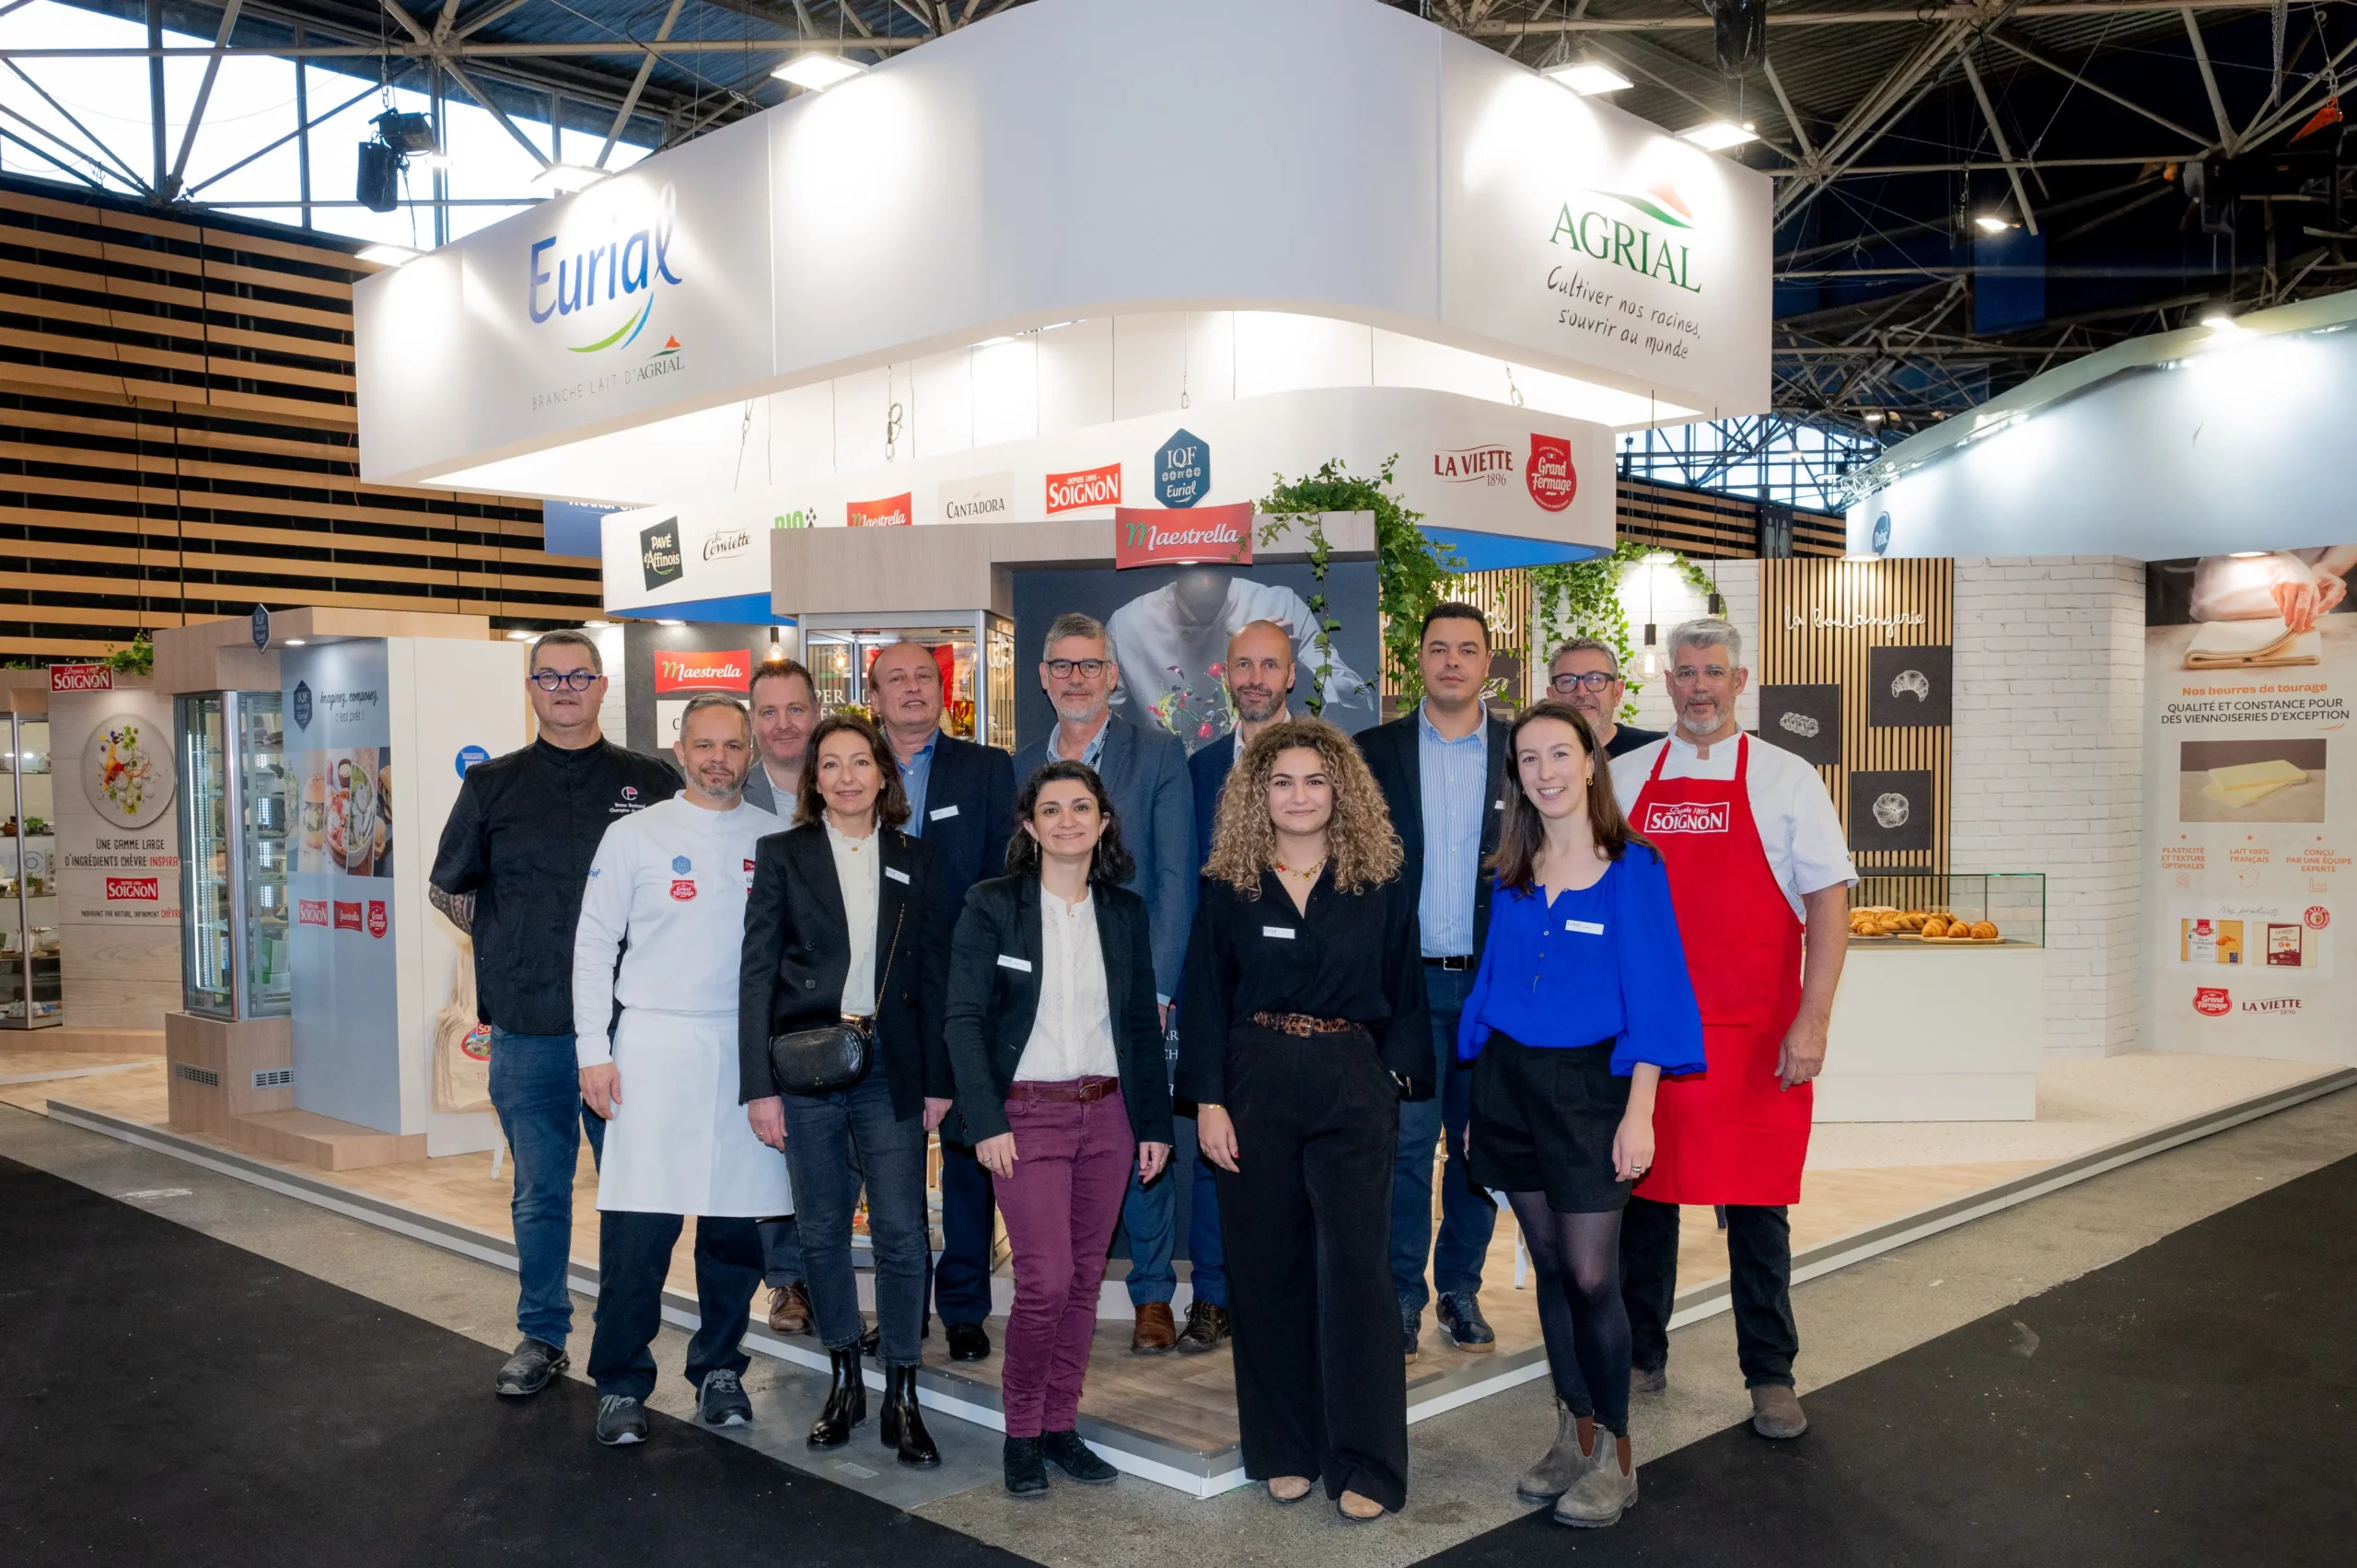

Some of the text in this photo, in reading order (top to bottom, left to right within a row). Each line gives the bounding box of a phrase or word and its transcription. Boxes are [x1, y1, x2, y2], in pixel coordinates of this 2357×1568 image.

[528, 181, 683, 324] Eurial
[1548, 201, 1702, 294] AGRIAL
[1547, 264, 1701, 340] Cultiver nos racines,
[1558, 308, 1689, 360] s'ouvrir au monde
[531, 356, 685, 412] BRANCHE LAIT D'AGRIAL
[1167, 446, 1198, 469] IQF
[1434, 454, 1458, 477] LA
[1461, 449, 1514, 475] VIETTE
[1177, 470, 1185, 479] BY
[1538, 456, 1567, 478] Grand
[1067, 475, 1085, 485] DEPUIS
[1487, 472, 1507, 487] 1896
[1530, 472, 1572, 496] Fermage
[1049, 473, 1119, 508] SOIGNON
[1167, 480, 1197, 498] Eurial
[946, 497, 1005, 519] CANTADORA
[650, 532, 672, 551] PAVÉ
[1125, 522, 1239, 552] Maestrella
[1875, 528, 1888, 549] Debic
[644, 551, 680, 570] d'Affinois
[1783, 605, 1926, 639] la boulangerie
[662, 660, 743, 681] Maestrella
[53, 672, 110, 689] SOIGNON
[2182, 683, 2328, 696] Nos beurres de tourage
[2167, 698, 2343, 714] QUALITÉ ET CONSTANCE POUR
[335, 711, 349, 723] c'est
[2161, 710, 2350, 725] DES VIENNOISERIES D'EXCEPTION
[1665, 806, 1709, 816] Depuis 1895
[1650, 811, 1724, 830] SOIGNON
[95, 838, 165, 850] UNE GAMME LARGE
[2162, 846, 2205, 854] PLASTICITÉ
[64, 853, 180, 867] D'INGRÉDIENTS CHÈVRE INSPIRA
[2230, 855, 2270, 864] FRANÇAIS
[2304, 849, 2335, 857] CONÇU
[2322, 855, 2352, 865] ÉQUIPE
[108, 882, 157, 898] SOIGNON
[134, 910, 159, 918] INFINIMENT
[299, 905, 327, 923] SOIGNON
[2197, 1001, 2228, 1010] Fermage
[2201, 994, 2224, 1004] Grand
[2242, 999, 2303, 1012] LA VIETTE
